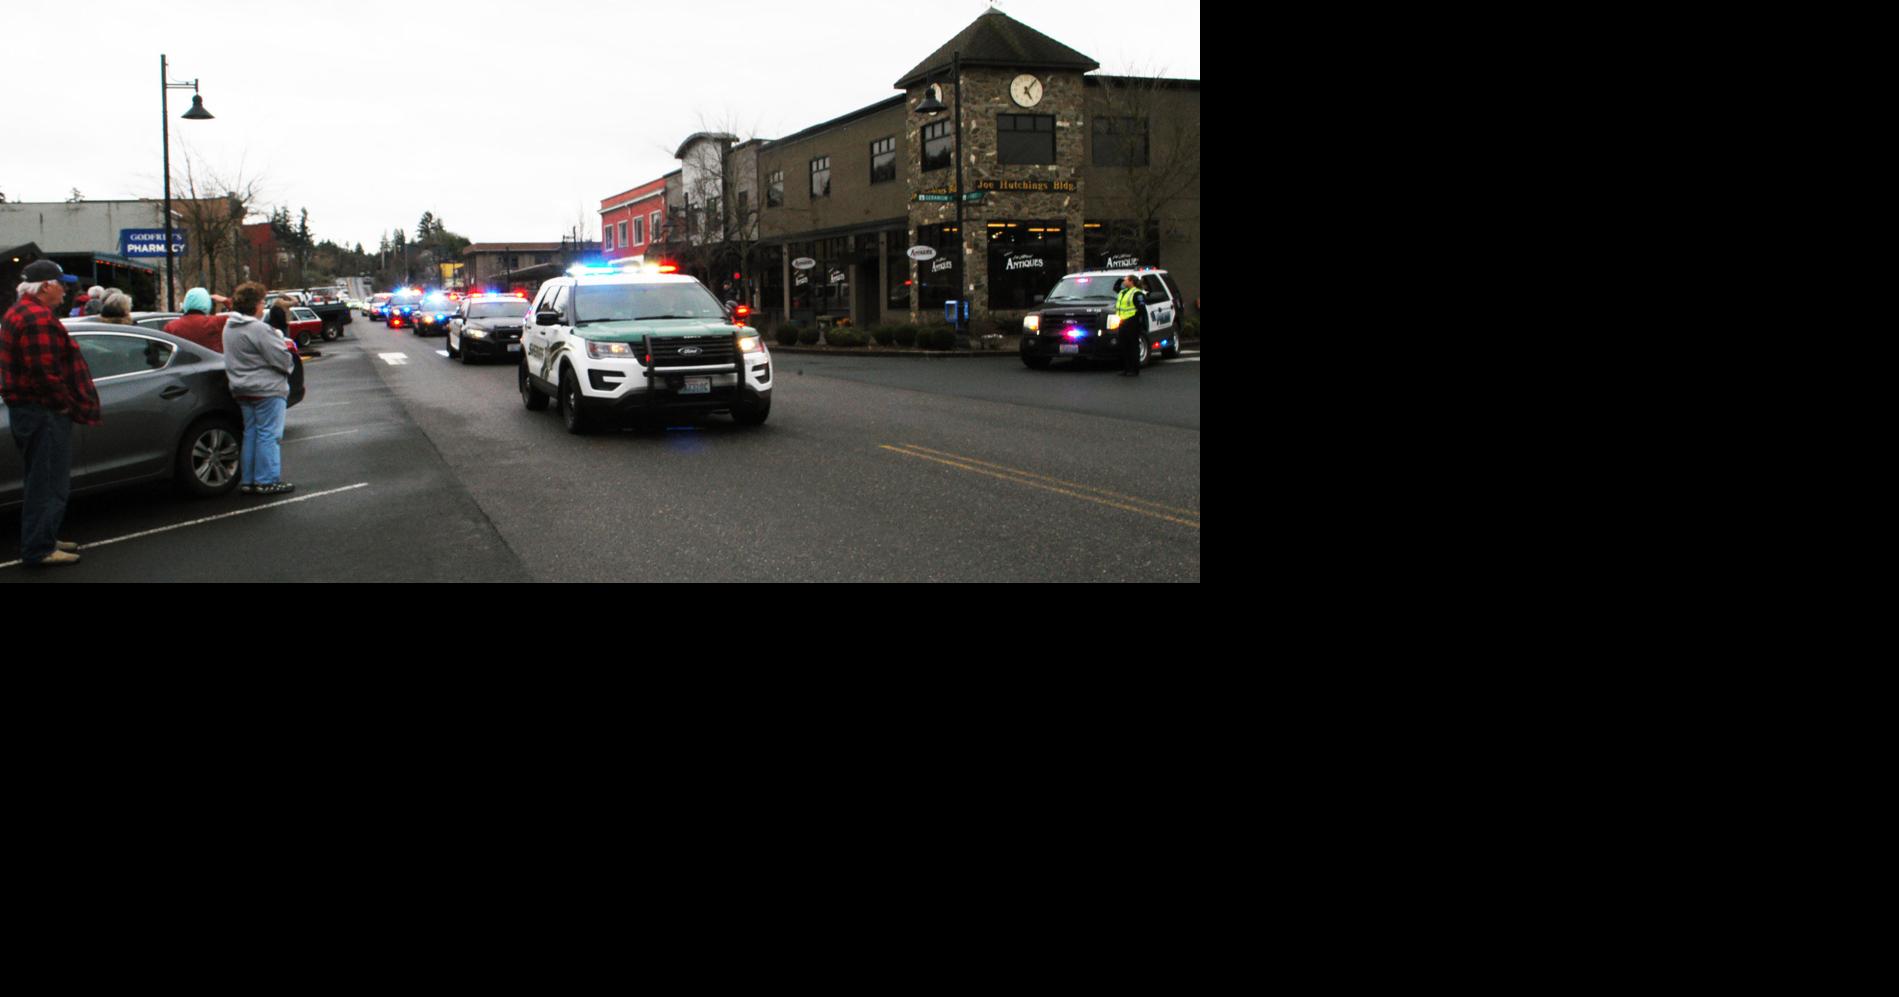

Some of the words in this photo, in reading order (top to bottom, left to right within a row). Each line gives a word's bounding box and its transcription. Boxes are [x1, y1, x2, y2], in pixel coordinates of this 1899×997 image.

[978, 180, 994, 190] Joe
[1000, 180, 1048, 191] Hutchings
[1006, 257, 1044, 270] ANTIQUES
[1106, 256, 1138, 268] ANTIQUE
